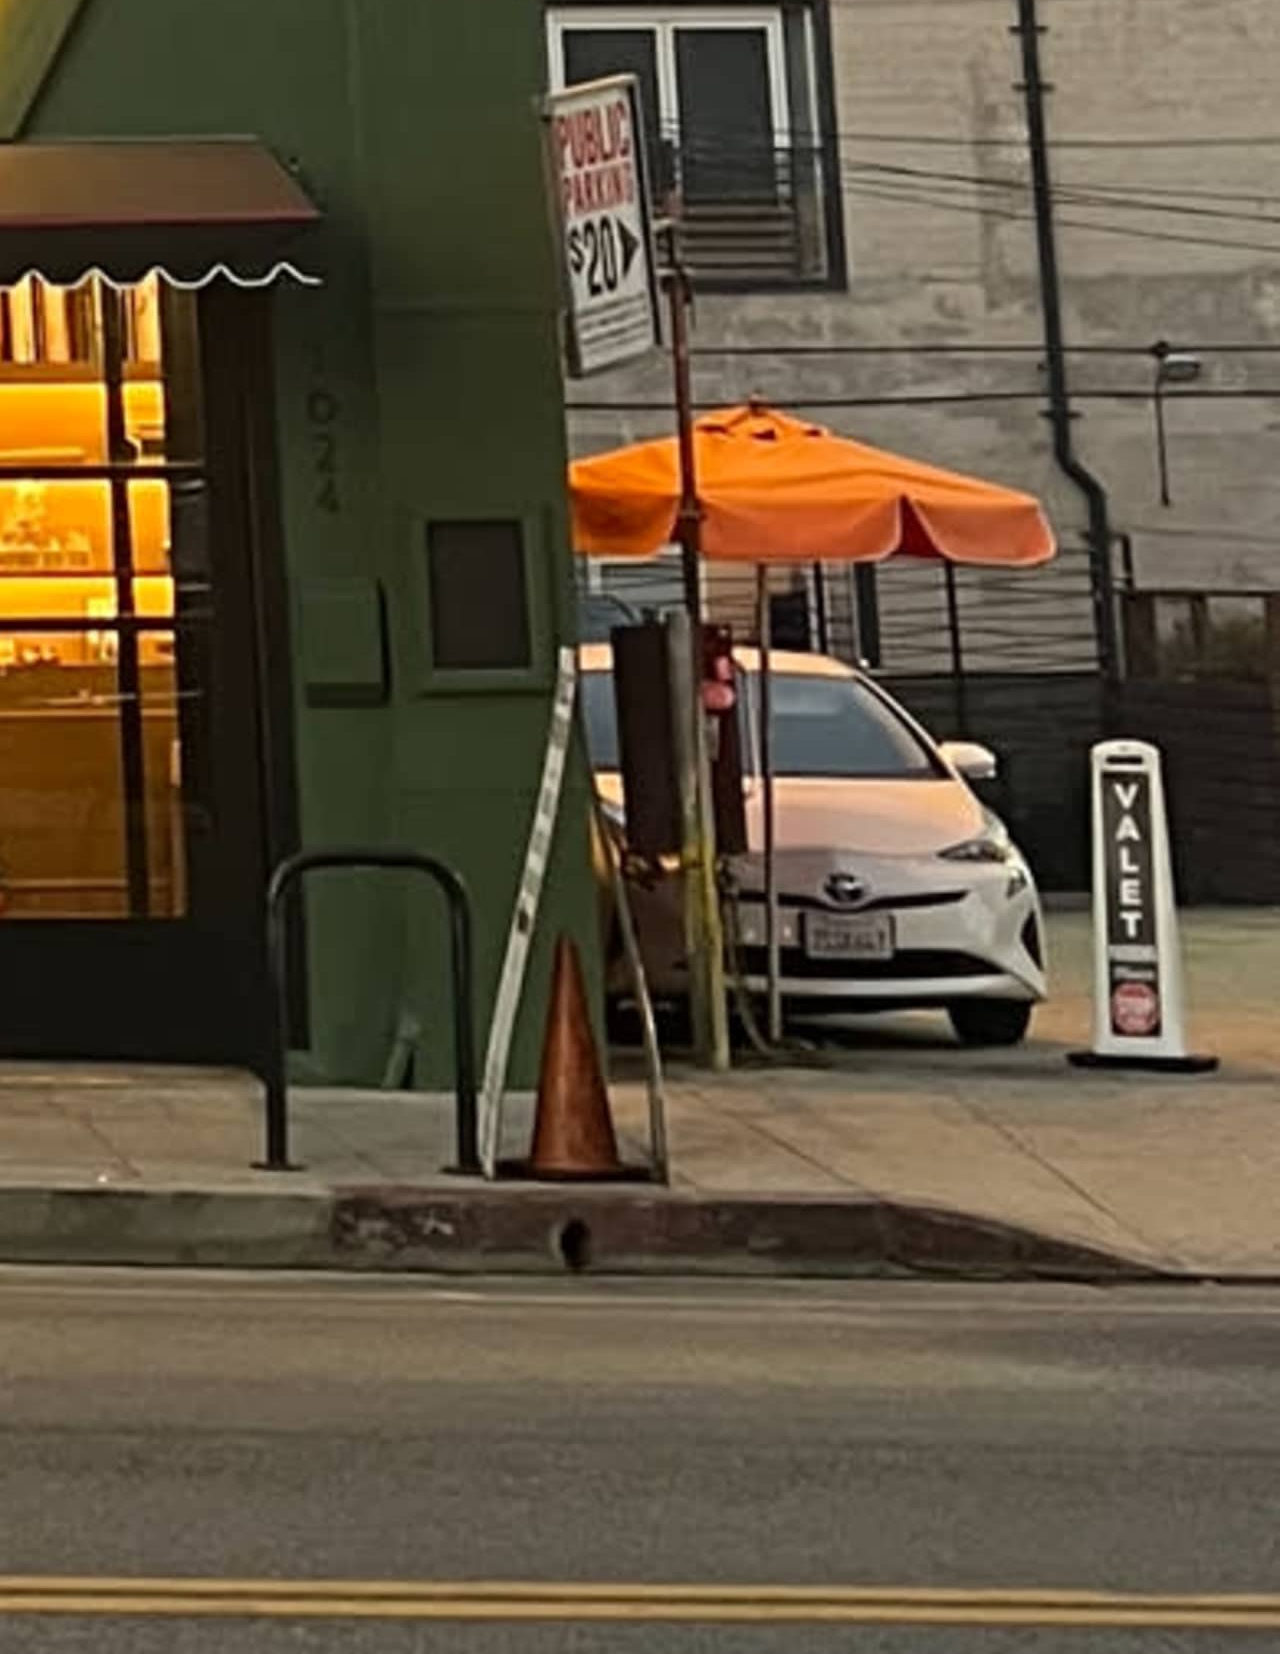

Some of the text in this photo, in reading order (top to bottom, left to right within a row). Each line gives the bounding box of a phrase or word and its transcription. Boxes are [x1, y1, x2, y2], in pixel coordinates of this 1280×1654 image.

[552, 98, 631, 174] PUBLIC
[562, 164, 636, 218] PARKING
[568, 217, 619, 298] $20
[1112, 781, 1144, 939] VALET
